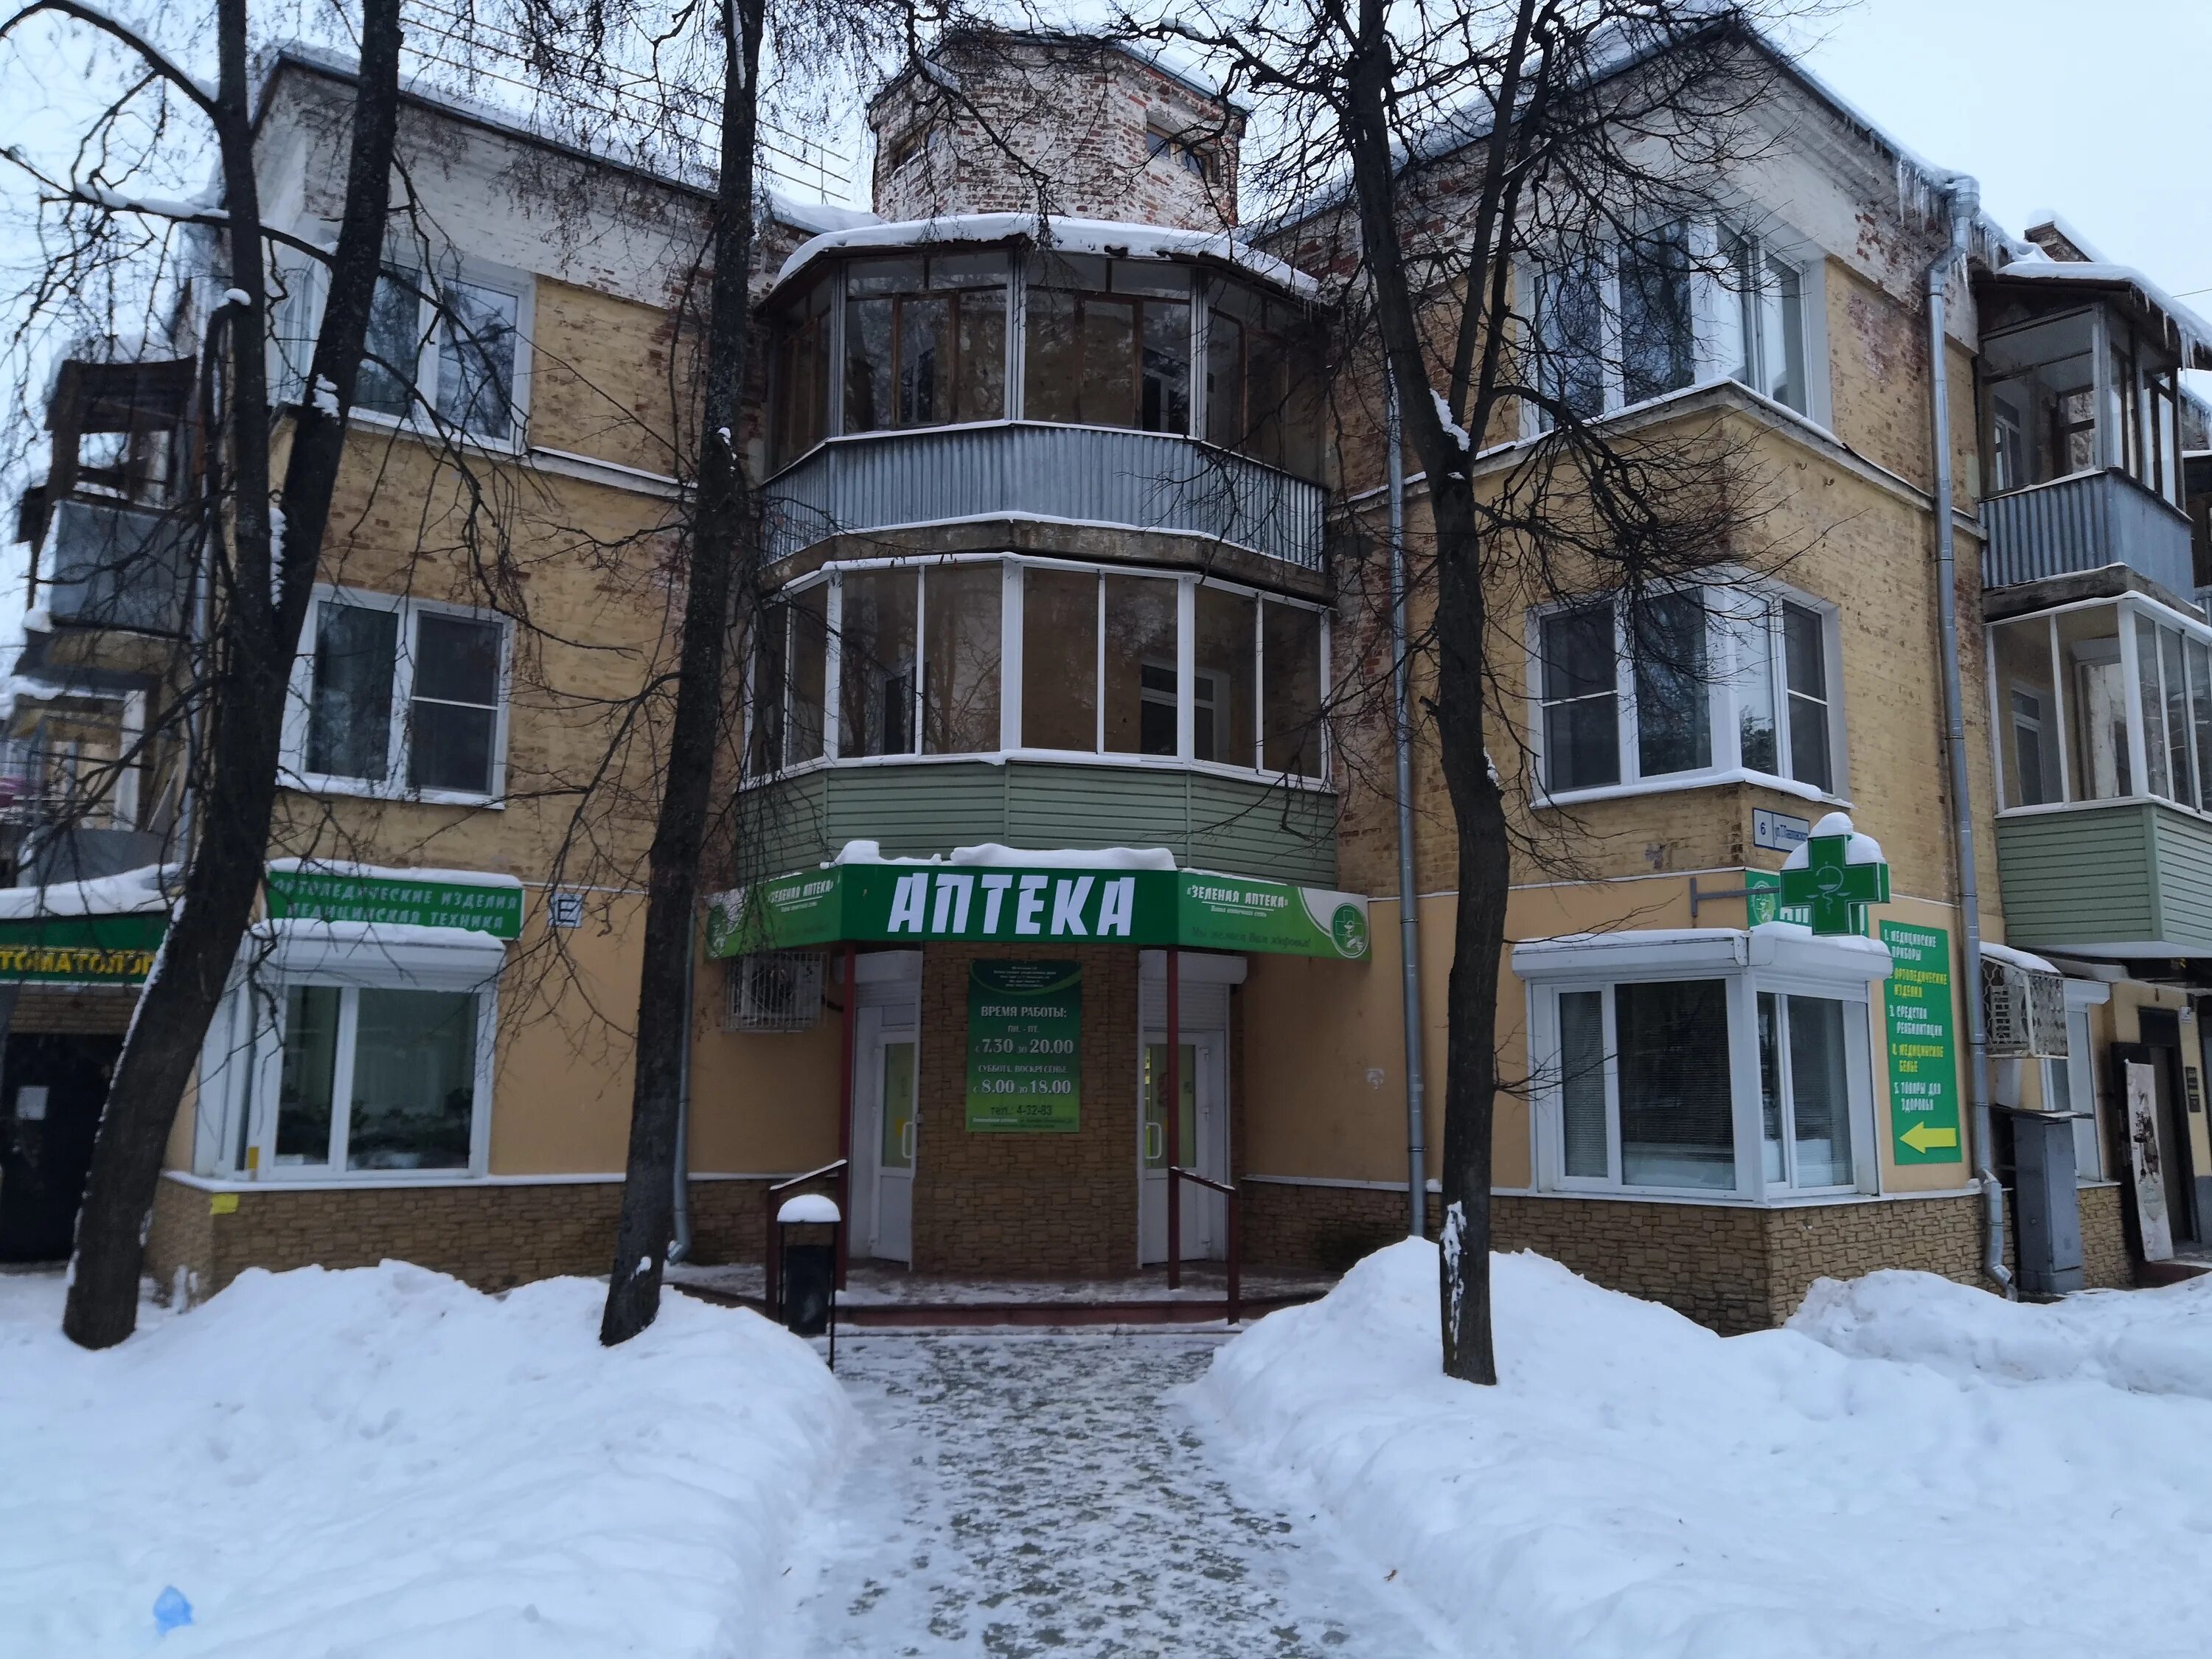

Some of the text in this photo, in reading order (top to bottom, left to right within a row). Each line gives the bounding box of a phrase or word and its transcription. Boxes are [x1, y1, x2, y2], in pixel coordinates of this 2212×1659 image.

[1759, 821, 1767, 836] 6
[441, 891, 518, 910] ИЗДЕЛИЯ
[1186, 884, 1289, 908] «ЗЕЛЕНАЯ АПТЕКА»
[887, 873, 1135, 936] АПТЕКА
[286, 902, 504, 930] МЕДИЦИНСКАЯ ТЕХНИКА
[1891, 931, 1936, 947] МЕДИЦИНСКИЕ
[1892, 946, 1921, 961] ПРИБОРЫ
[1894, 967, 1947, 985] ОРТОПЕДИЧЕСКИЕ
[981, 1006, 1067, 1018] ВРЕМЯ РАБОТЫ:
[1896, 1005, 1927, 1020] СРЕДСТВА
[982, 1038, 1014, 1054] 7.30
[1030, 1039, 1074, 1054] 20.00
[1015, 1065, 1068, 1074] ВОСКРЕСЕНЬЕ
[981, 1079, 1015, 1093] 8.00
[1030, 1080, 1071, 1094] 18.00
[1901, 1082, 1926, 1095] ТОВАРЫ
[1928, 1082, 1941, 1096] ДЛЯ
[1016, 1105, 1053, 1116] 4-32-83
[1901, 1098, 1934, 1113] ЗДОРОВЬЯ
